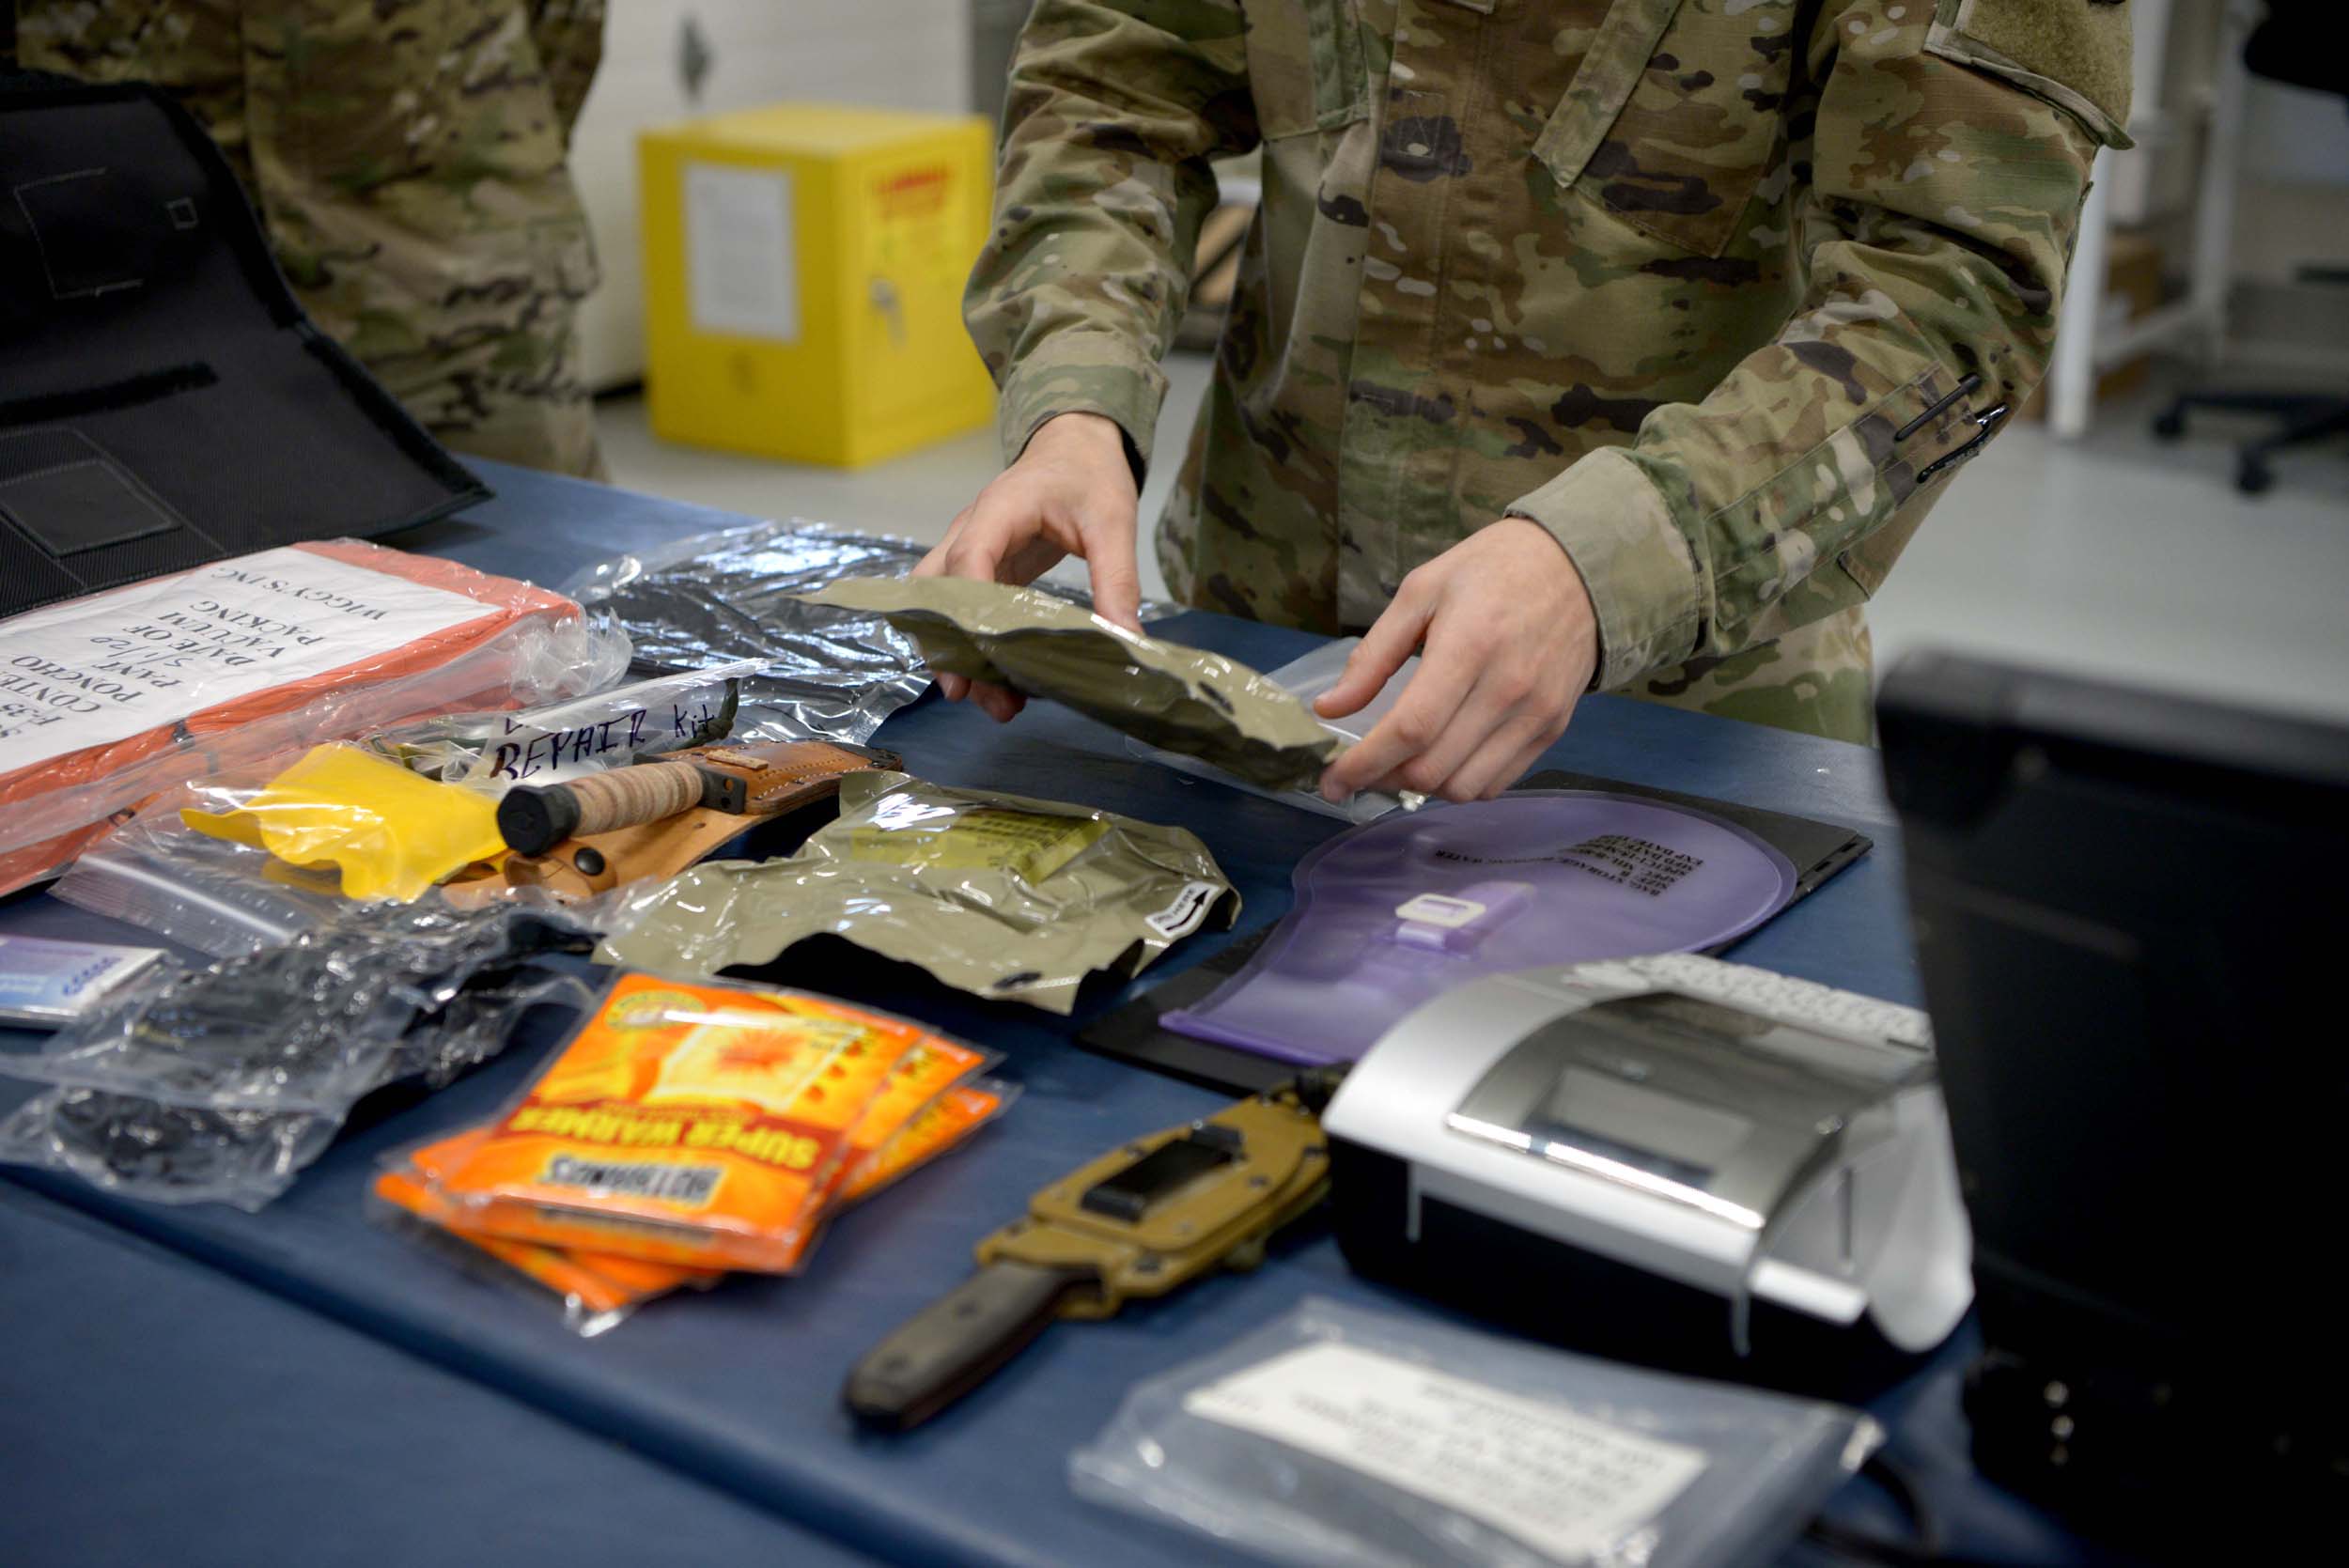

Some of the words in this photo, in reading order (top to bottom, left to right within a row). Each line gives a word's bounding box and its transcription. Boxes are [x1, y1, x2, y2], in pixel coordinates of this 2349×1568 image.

[122, 624, 173, 641] OF
[158, 611, 286, 659] VACUUM
[190, 600, 325, 646] PACKING
[91, 661, 183, 688] PANT
[167, 638, 257, 667] DATE
[0, 674, 101, 714] CONTE
[11, 656, 144, 703] PONCHO
[490, 708, 647, 781] REPAIR
[683, 1121, 821, 1169] SUPER
